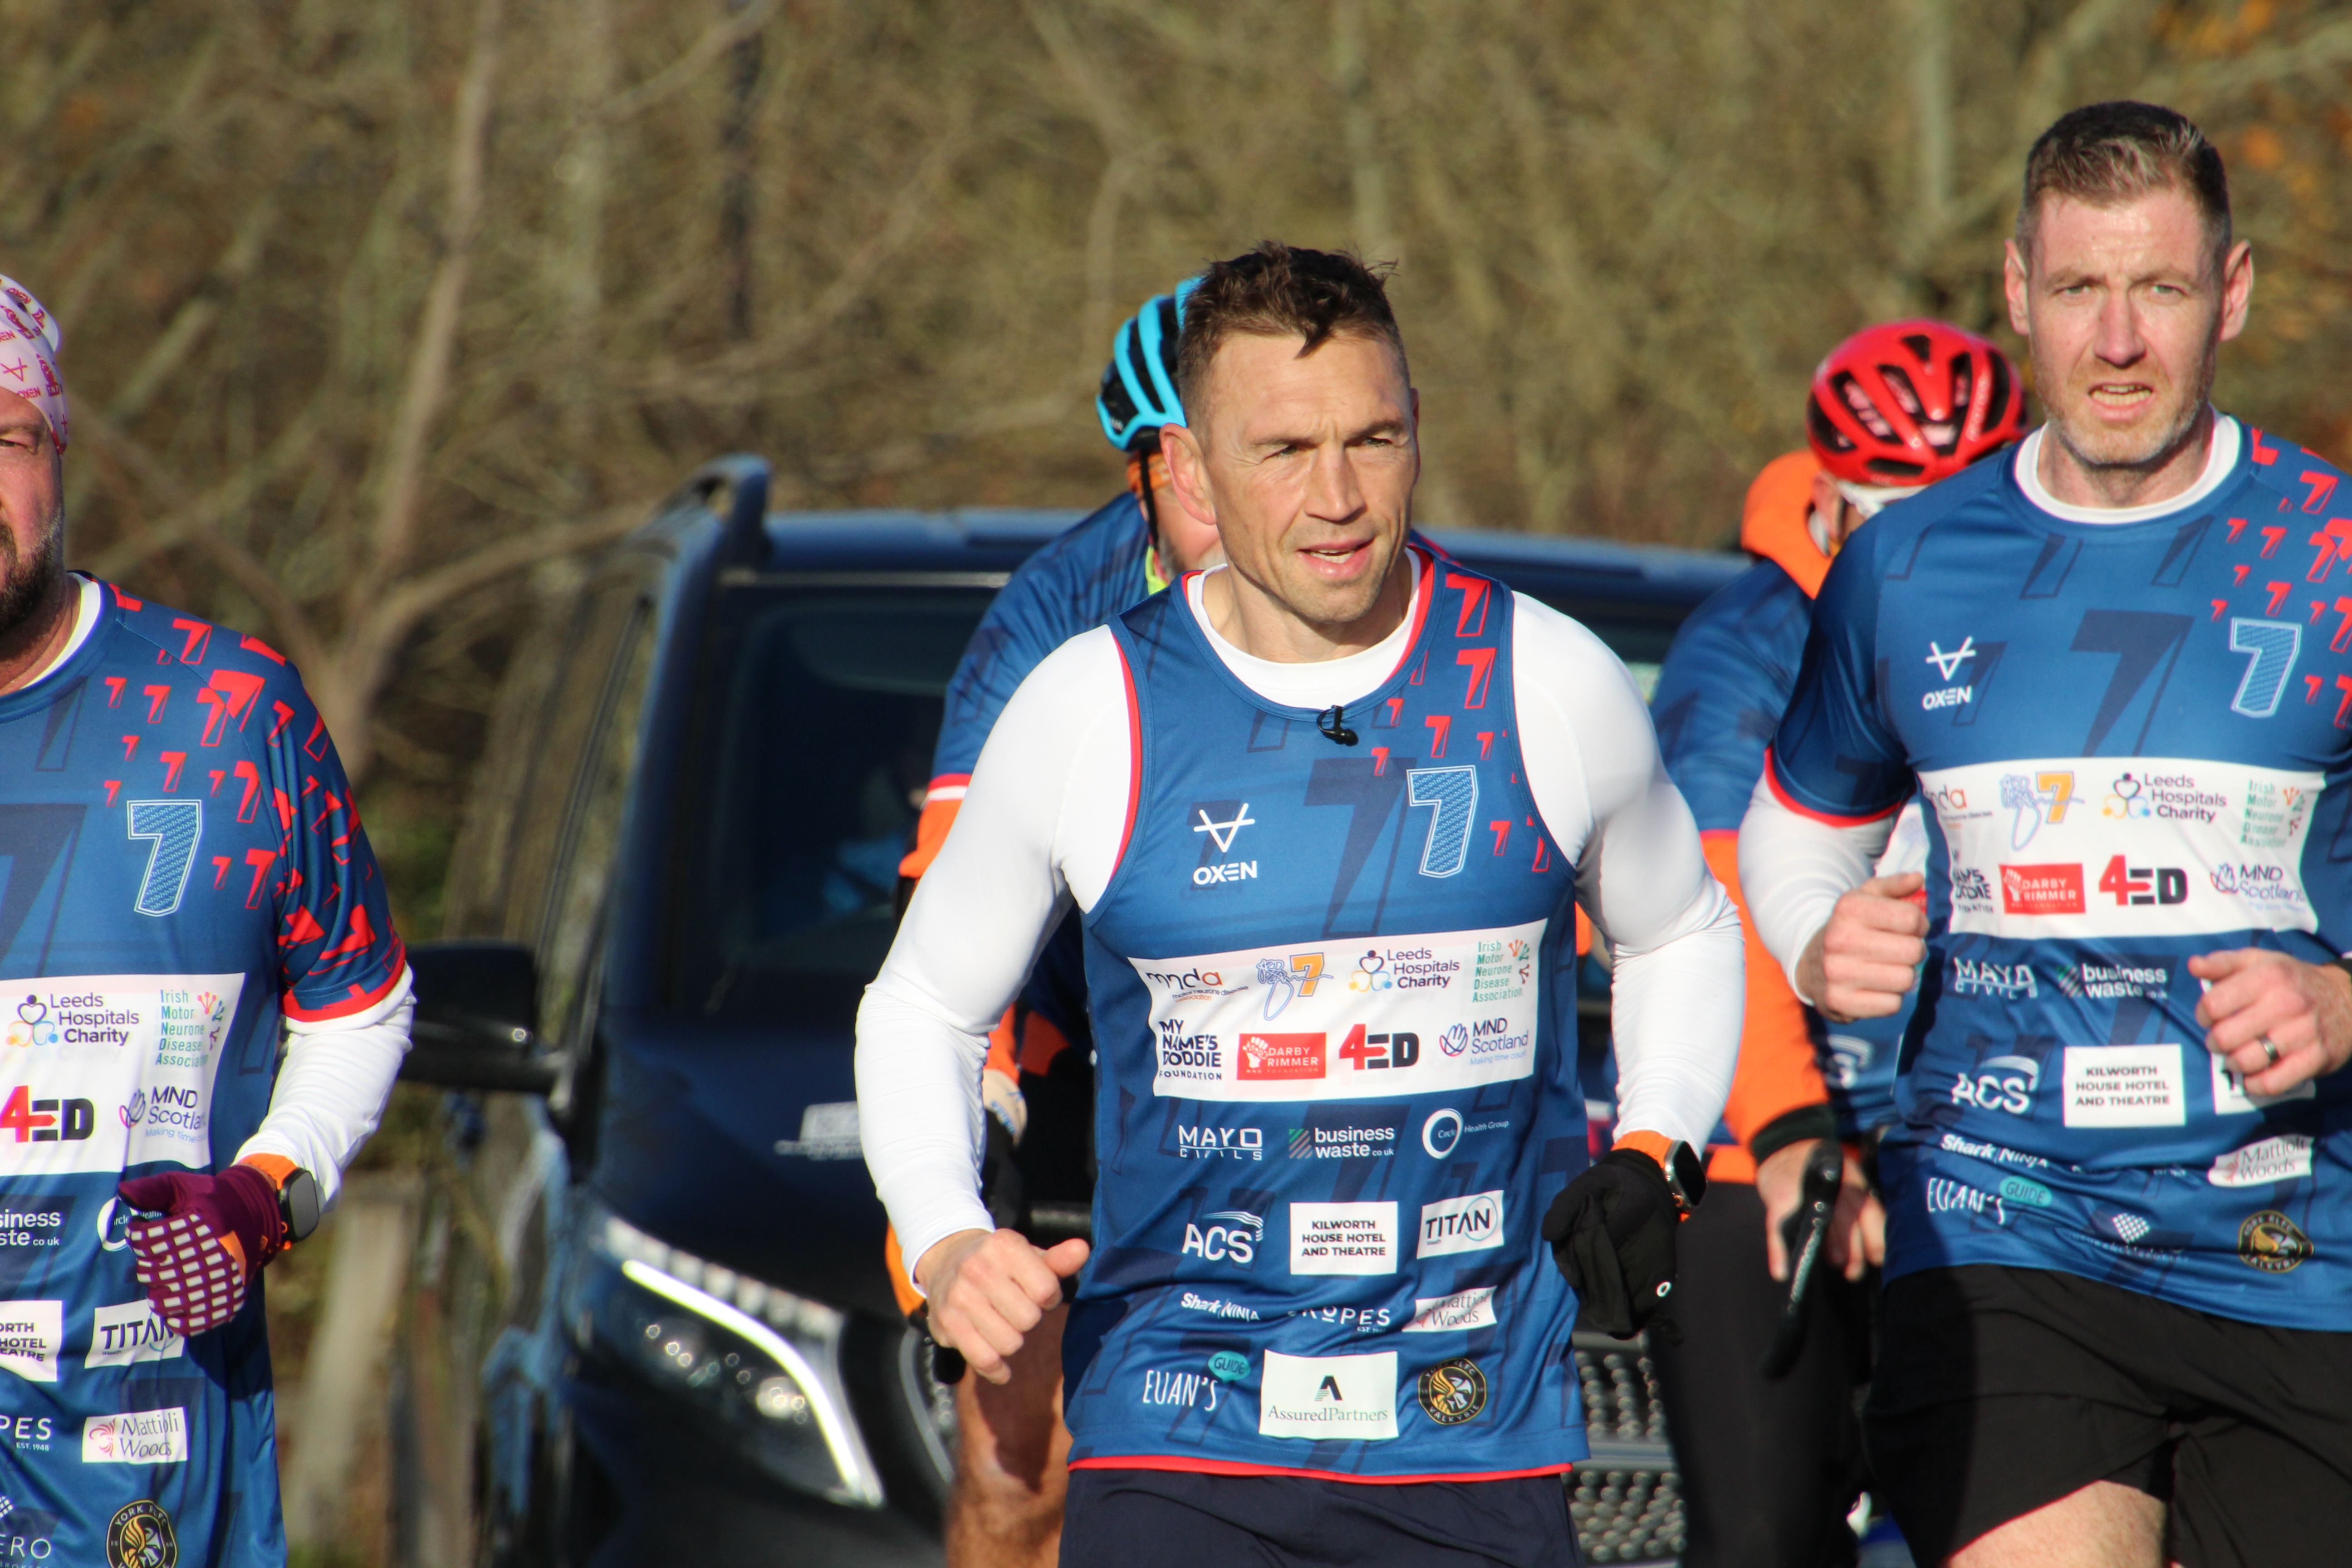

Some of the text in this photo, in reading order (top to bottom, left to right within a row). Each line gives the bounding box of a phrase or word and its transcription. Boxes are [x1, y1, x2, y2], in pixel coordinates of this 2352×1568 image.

[2230, 617, 2301, 718] 7
[1922, 686, 1972, 710] OXEN
[2145, 773, 2195, 787] Leeds
[2036, 771, 2074, 823] 7
[2152, 789, 2227, 806] Hospitals
[1406, 764, 1478, 877] 7
[2157, 804, 2216, 824] Charity
[127, 799, 202, 917] 7
[1193, 861, 1257, 885] OXEN
[2240, 864, 2283, 881] MND
[2022, 878, 2067, 889] DARBY
[2024, 890, 2076, 901] RIMMER
[1387, 947, 1432, 961] Leeds
[1478, 941, 1501, 952] Irish
[1394, 960, 1460, 975] Hospitals
[1477, 954, 1503, 965] Motor
[1289, 952, 1324, 997] 7
[1475, 965, 1512, 977] Neurone
[2082, 963, 2167, 983] business
[1397, 975, 1450, 988] Charity
[1474, 978, 1509, 990] Disease
[2086, 981, 2143, 999] waste
[50, 992, 103, 1008] Leeds
[161, 989, 188, 1003] Irish
[1472, 987, 1522, 1003] Association
[59, 1009, 139, 1028] Hospitals
[161, 1006, 194, 1019] Motor
[1159, 1019, 1184, 1034] MY
[1473, 1018, 1507, 1037] MND
[64, 1027, 129, 1046] Charity
[159, 1038, 202, 1051] Disease
[1162, 1034, 1218, 1051] NAME'S
[1471, 1029, 1528, 1054] Scotland
[1269, 1047, 1310, 1056] DARBY
[1339, 1024, 1419, 1070] 4ED
[1163, 1050, 1221, 1067] DODDIE
[1267, 1057, 1318, 1066] RIMMER
[1159, 1070, 1222, 1080] FOUNDATION
[2086, 1066, 2157, 1076] KILWORTH
[1951, 1073, 2029, 1114] ACS
[2076, 1080, 2169, 1091] HOUSE HOTEL
[151, 1086, 198, 1108] MND
[2076, 1095, 2170, 1105] AND THEATRE
[148, 1106, 206, 1130] Scotla
[1315, 1126, 1394, 1143] business
[1464, 1121, 1509, 1133] Health Group
[1179, 1125, 1262, 1148] MAYO
[1180, 1149, 1262, 1161] CIVILS
[1315, 1142, 1370, 1158] waste
[1941, 1134, 1996, 1159] Shark
[2006, 1181, 2046, 1202] GUIDE
[1927, 1177, 2006, 1225] EUAN'S
[1312, 1220, 1375, 1230] KILWORTH
[1426, 1208, 1490, 1239] TITAN
[1181, 1223, 1253, 1263] ACS
[1302, 1233, 1386, 1243] HOUSE HOTEL
[1302, 1247, 1386, 1256] AND THEATRE
[1181, 1292, 1260, 1322] Shark NINJA
[1432, 1310, 1479, 1326] Woods
[1214, 1357, 1245, 1374] GUIDE
[1142, 1369, 1218, 1412] EUAN'S
[1268, 1405, 1388, 1421] AssuredPartners
[1429, 1405, 1480, 1422] VALKYRIE
[122, 1412, 179, 1436] Mattioli
[115, 1505, 143, 1526] YORK
